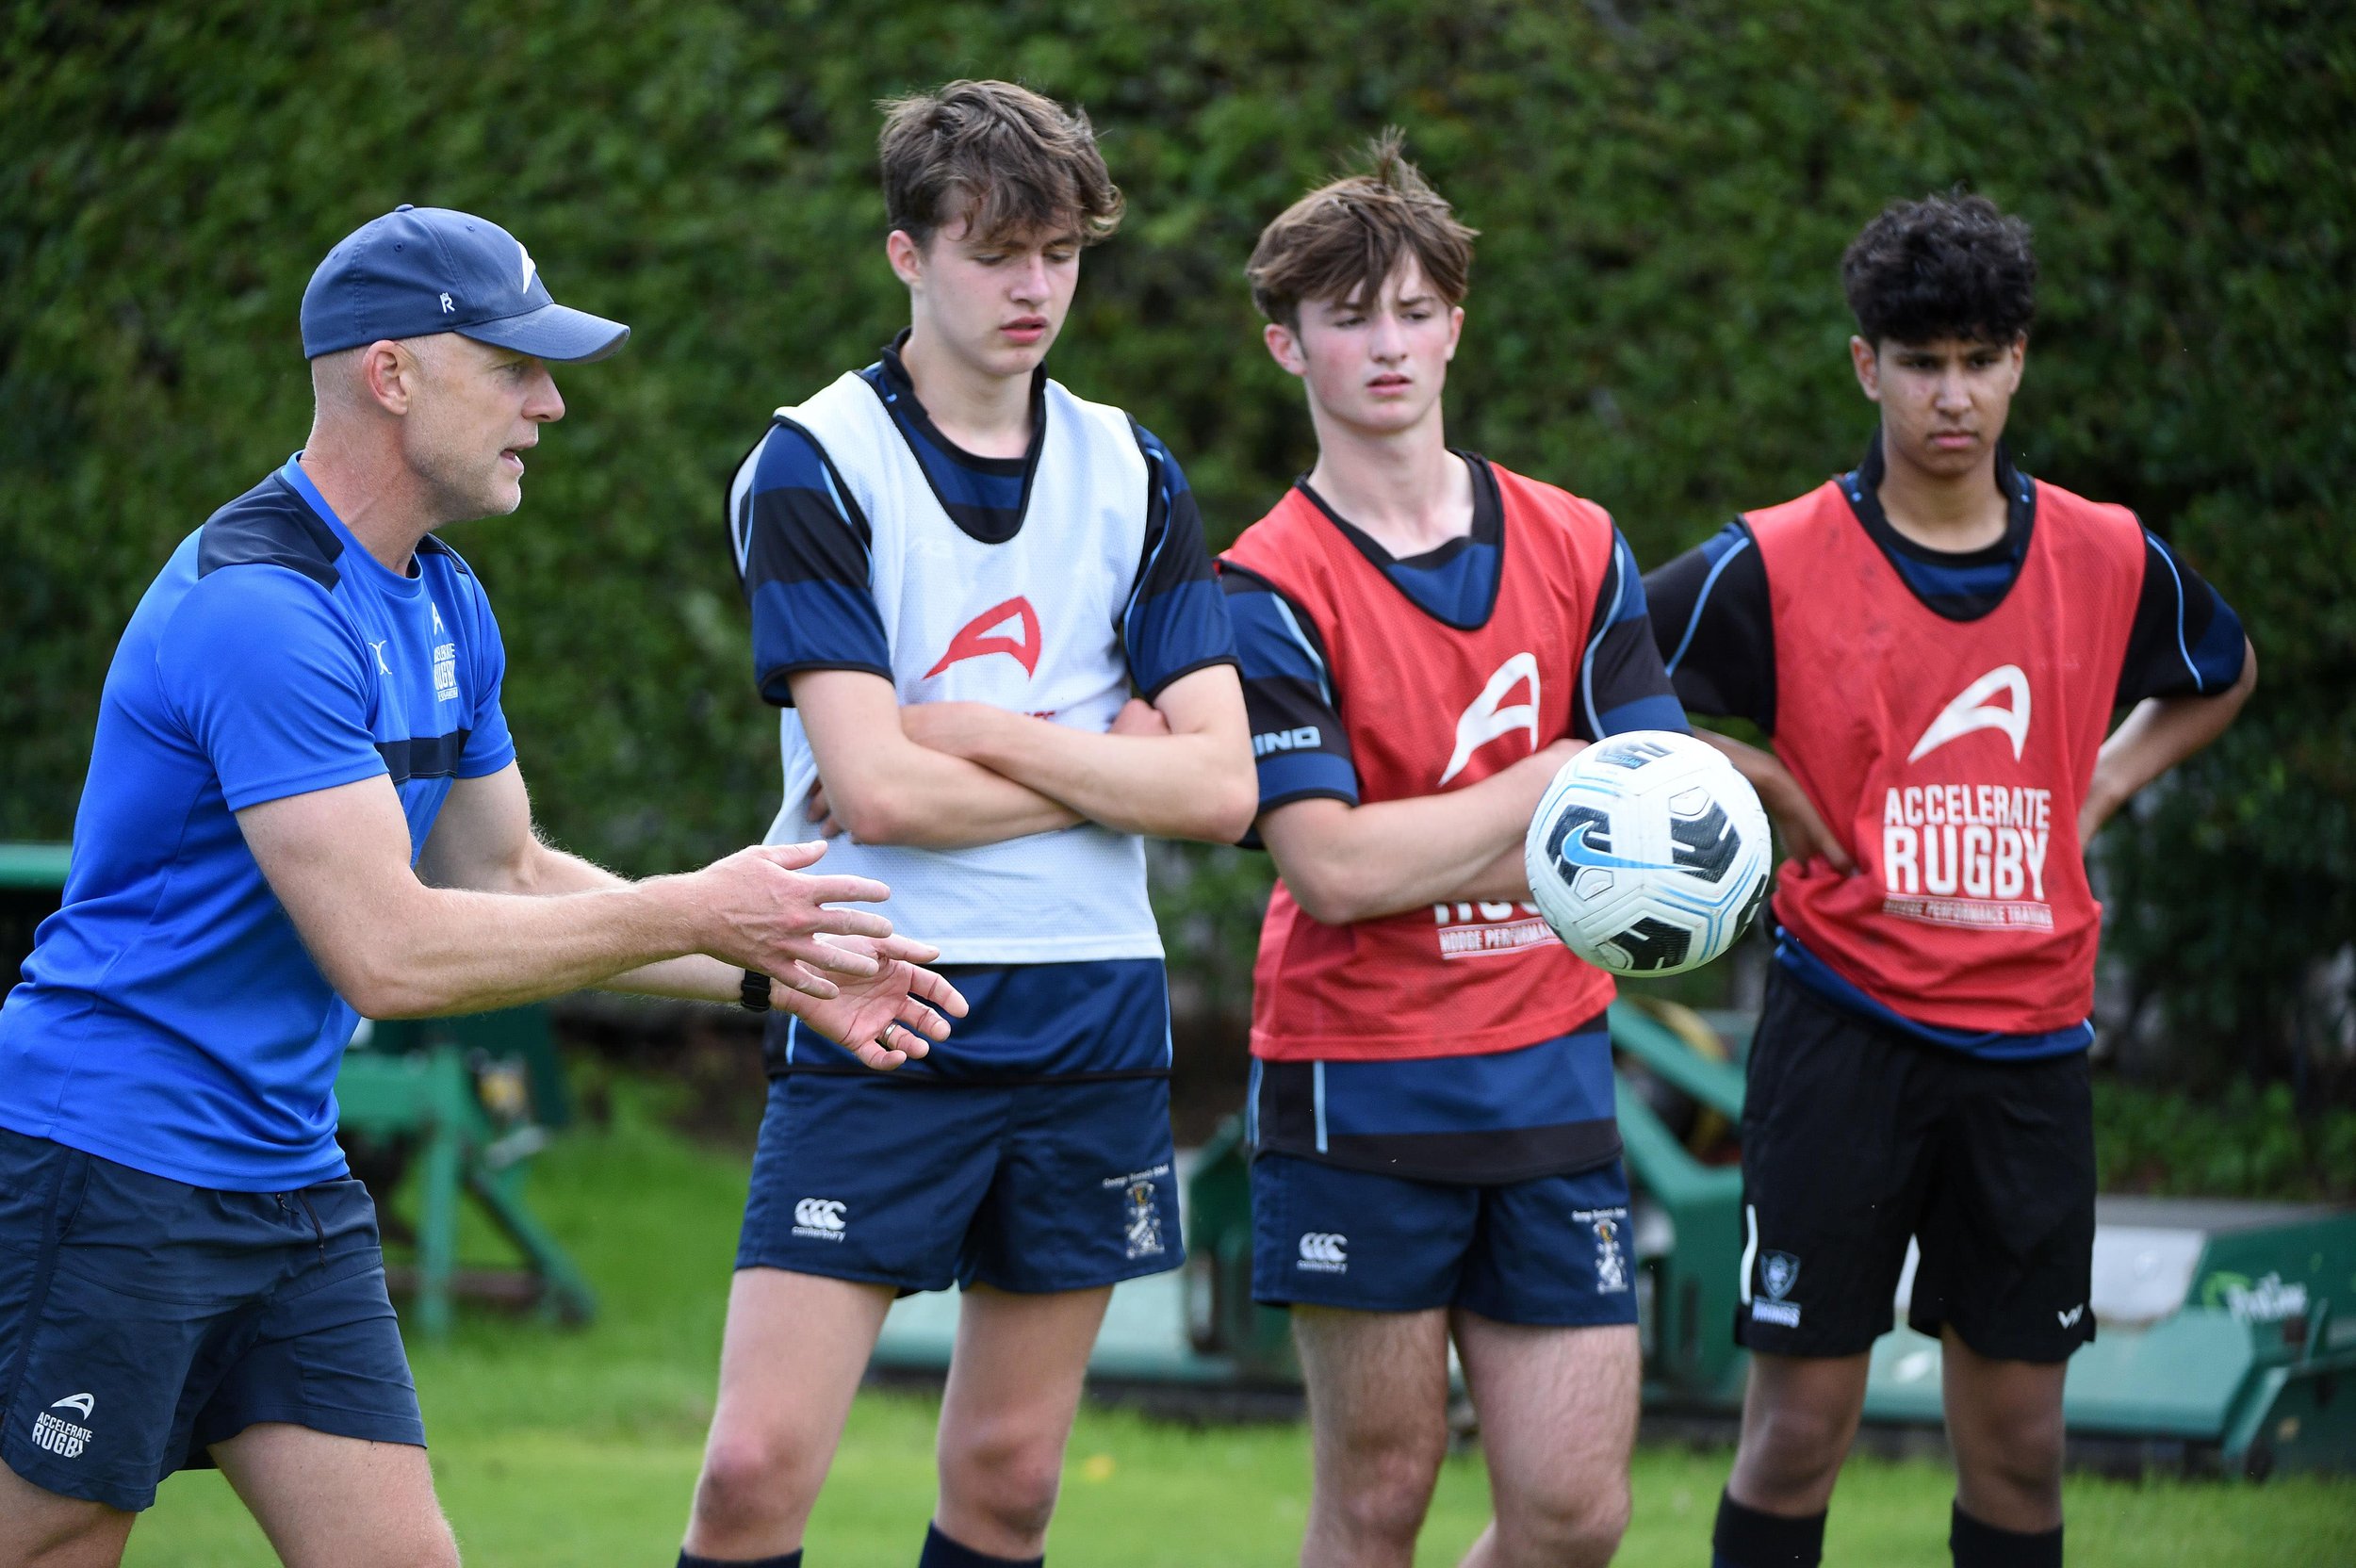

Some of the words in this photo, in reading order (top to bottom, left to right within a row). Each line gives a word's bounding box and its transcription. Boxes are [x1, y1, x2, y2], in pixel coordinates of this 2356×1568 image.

[1252, 725, 1322, 758] INO
[1883, 783, 2052, 831] ACCELERATE
[1883, 824, 2050, 902] RUGBY
[31, 1421, 84, 1459] RUGBY
[36, 1411, 93, 1444] ACCELERATE
